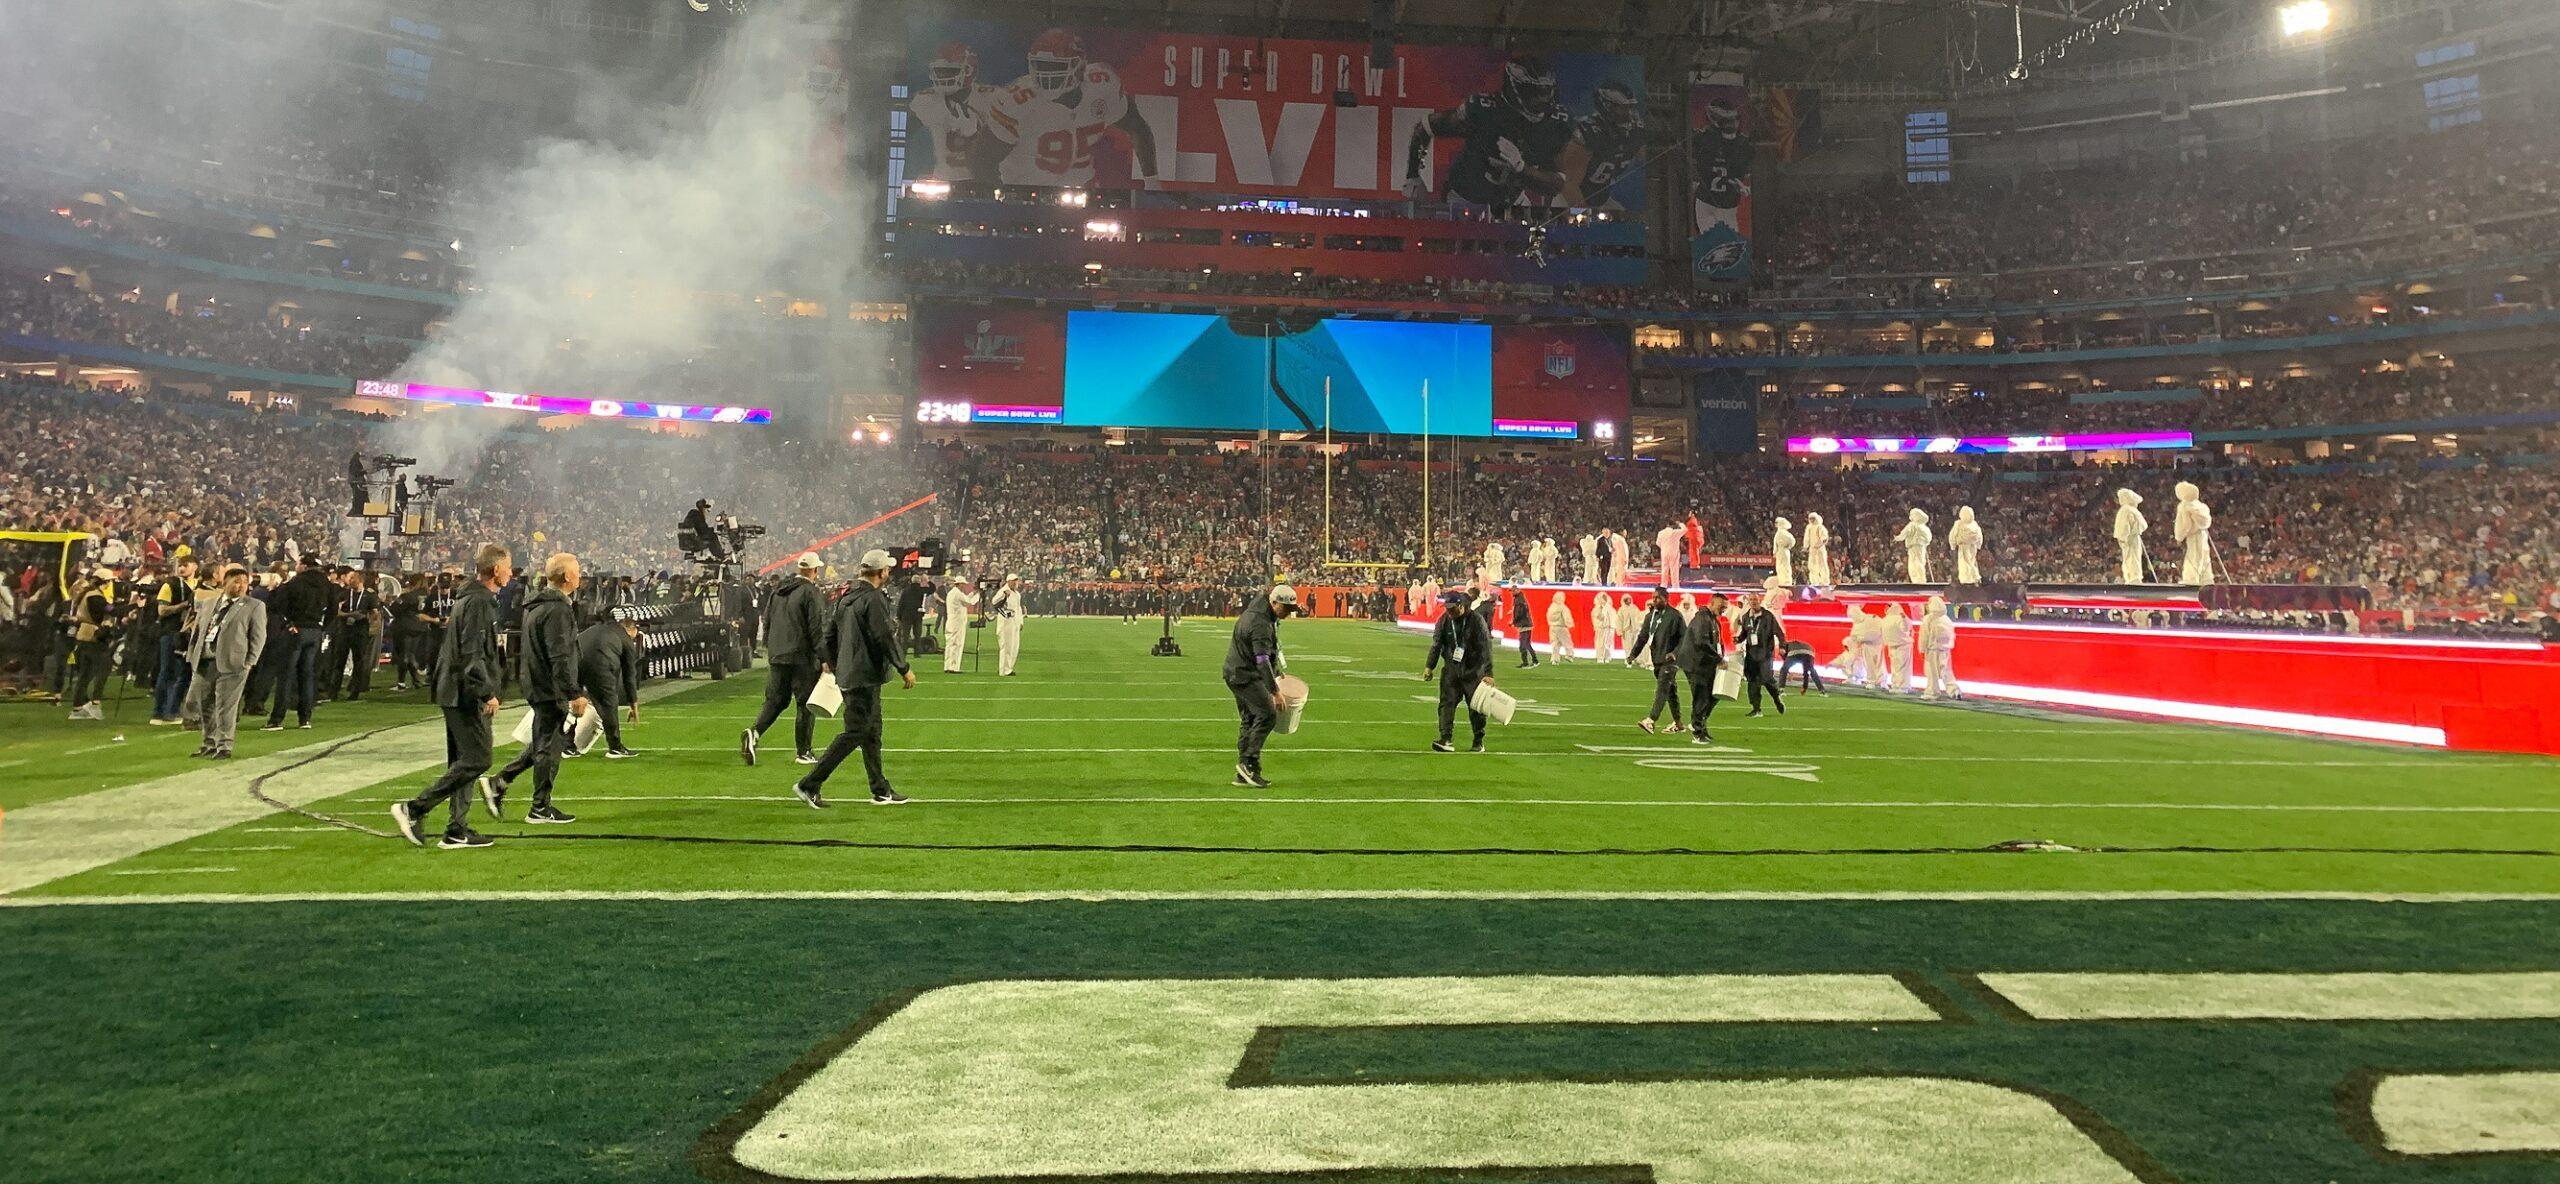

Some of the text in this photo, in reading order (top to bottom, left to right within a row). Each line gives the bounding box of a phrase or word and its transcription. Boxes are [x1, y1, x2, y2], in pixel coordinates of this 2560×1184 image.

[1164, 45, 1407, 98] SUPER BOWL
[1131, 95, 1435, 192] LVII
[1550, 357, 1572, 371] NFL
[362, 381, 398, 396] 23:48
[1701, 398, 1747, 410] verizon
[917, 402, 971, 422] 23:48
[1010, 410, 1037, 418] BOWL
